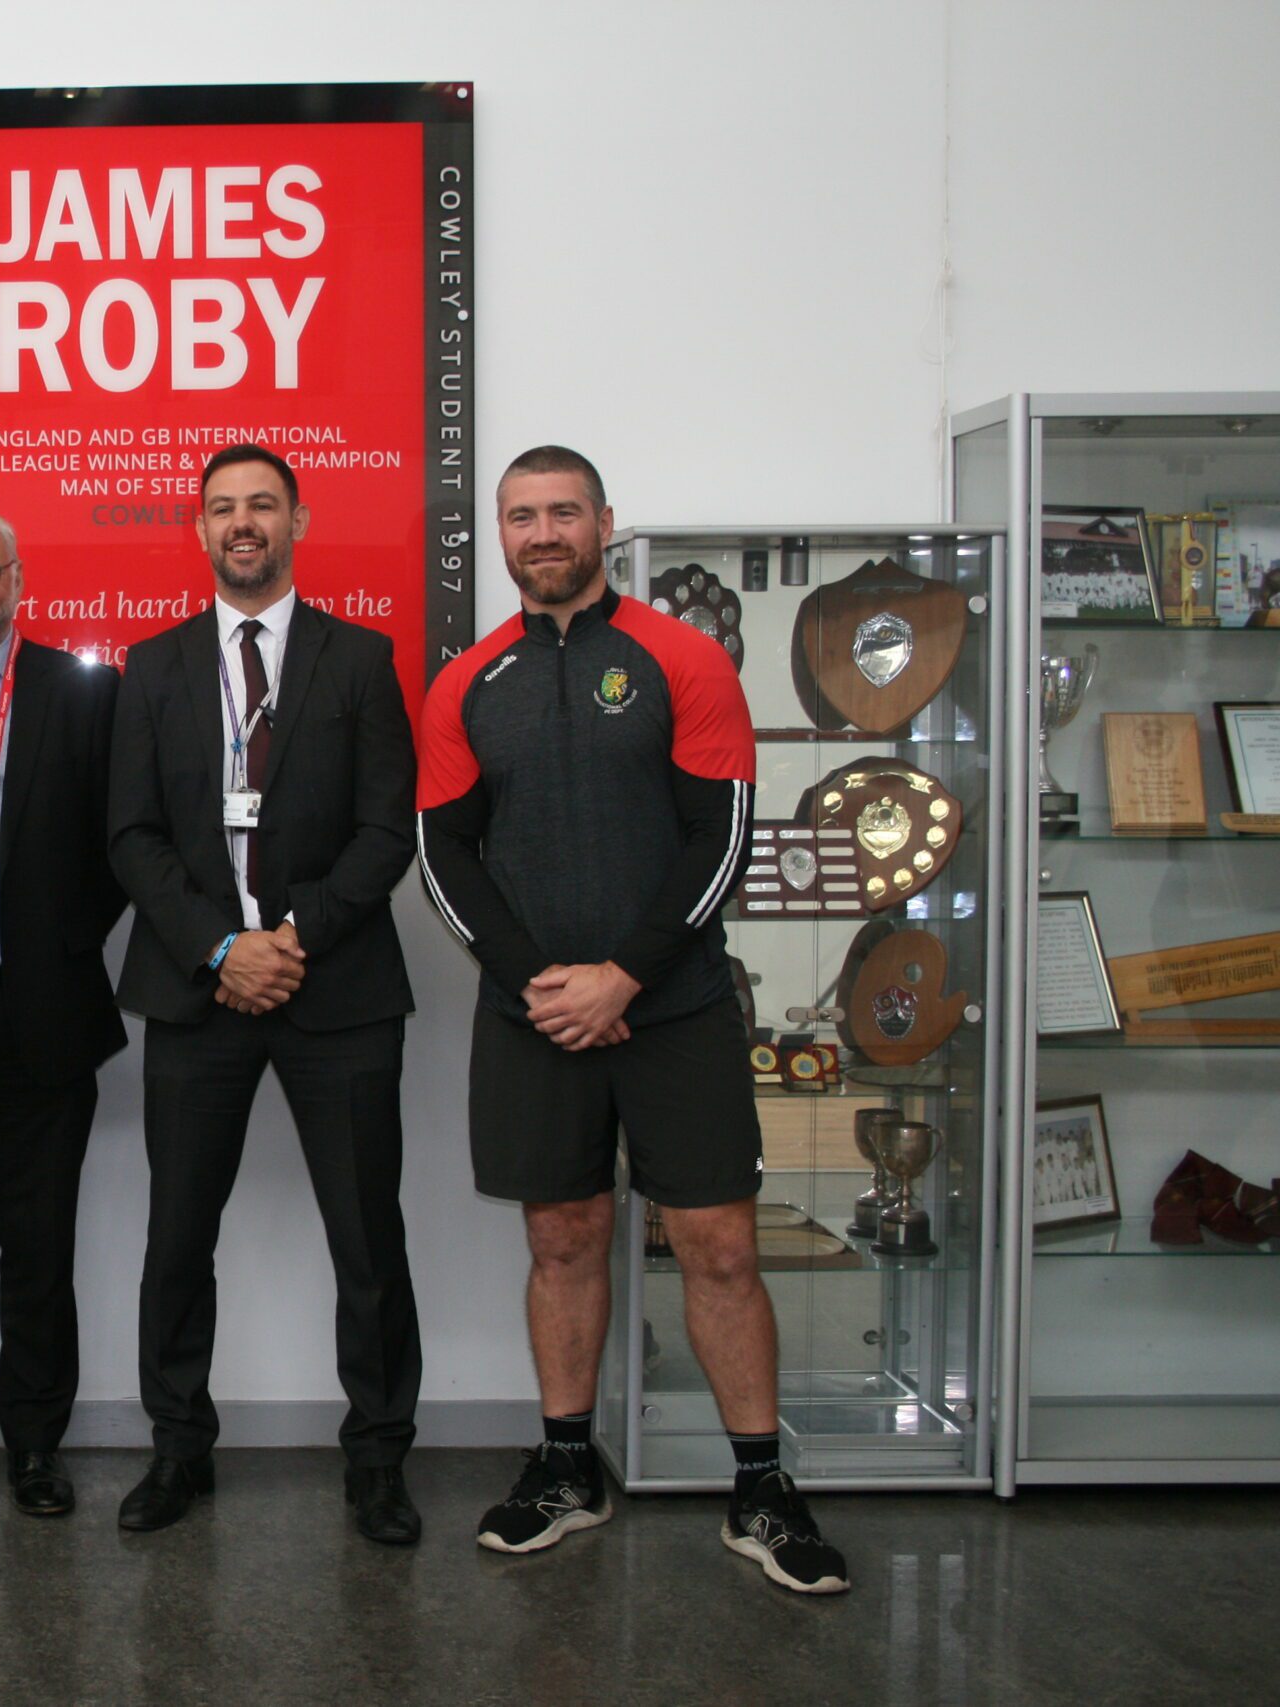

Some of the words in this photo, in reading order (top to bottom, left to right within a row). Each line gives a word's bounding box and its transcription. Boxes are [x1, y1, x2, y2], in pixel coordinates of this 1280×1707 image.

[440, 166, 461, 308] COWLEY
[440, 329, 462, 489] STUDENT
[88, 428, 135, 446] AND
[141, 428, 170, 446] GB
[178, 426, 347, 445] INTERNATIONAL
[0, 454, 81, 472] LEAGUE
[87, 453, 172, 471] WINNER
[179, 452, 195, 470] &
[285, 451, 401, 469] CHAMPION
[60, 479, 108, 496] MAN
[116, 478, 144, 495] OF
[150, 477, 202, 495] STEE
[441, 512, 462, 593] 1997
[47, 591, 108, 620] and
[117, 590, 190, 620] hard
[343, 588, 393, 617] the
